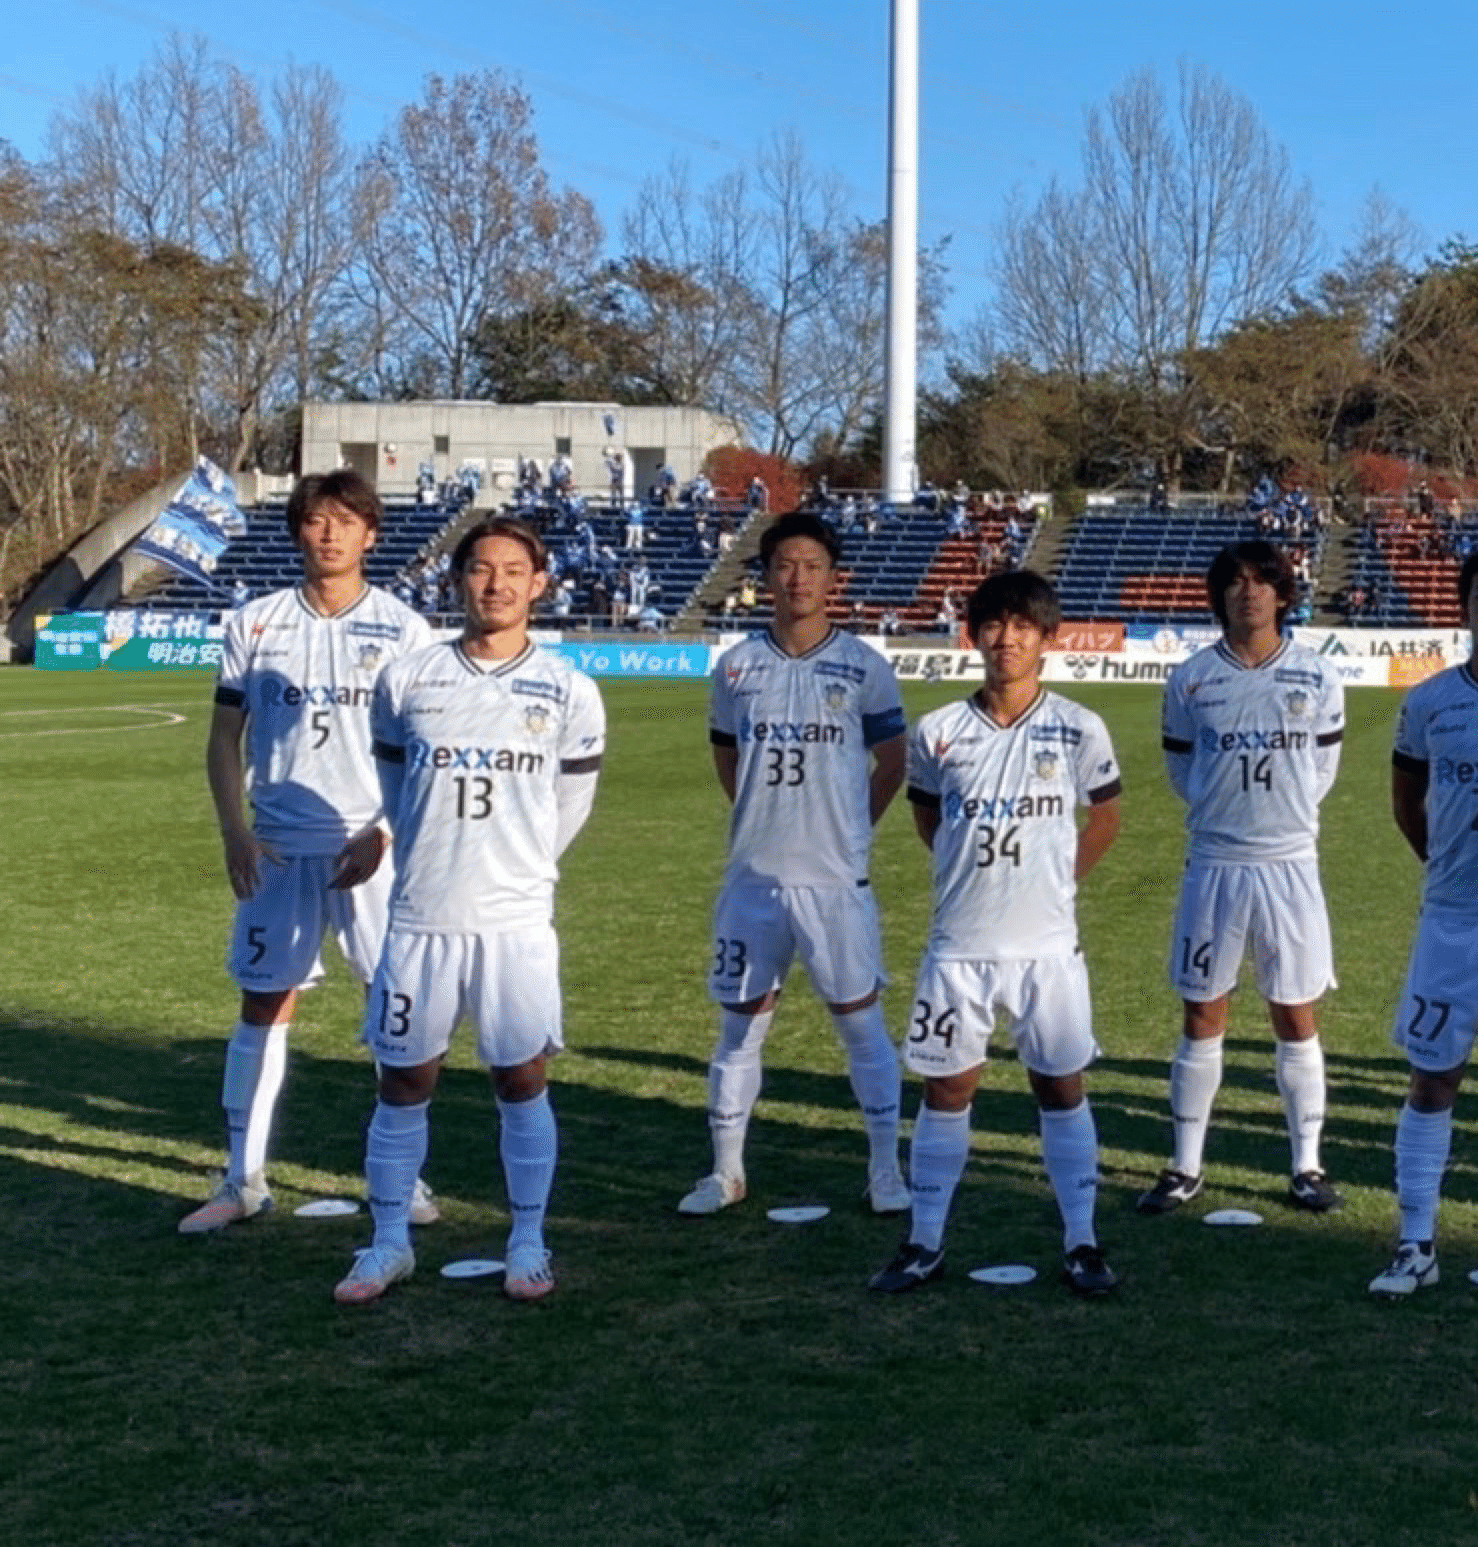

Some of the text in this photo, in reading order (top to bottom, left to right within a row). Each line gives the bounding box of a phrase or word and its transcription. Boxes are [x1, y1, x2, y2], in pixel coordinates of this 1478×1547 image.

[620, 649, 692, 671] Work
[312, 712, 330, 750] 5
[740, 722, 845, 745] Rexxam
[1202, 727, 1308, 753] Rexxam
[408, 739, 544, 773] Rexxam
[766, 748, 805, 786] 33
[1239, 754, 1272, 792] 14
[453, 776, 494, 820] 13
[946, 791, 1063, 819] Rexxam
[976, 826, 1022, 867] 34
[247, 927, 266, 965] 5
[713, 938, 747, 978] 33
[1182, 936, 1211, 978] 14
[380, 990, 412, 1037] 13
[909, 999, 957, 1049] 34
[1407, 994, 1451, 1043] 27
